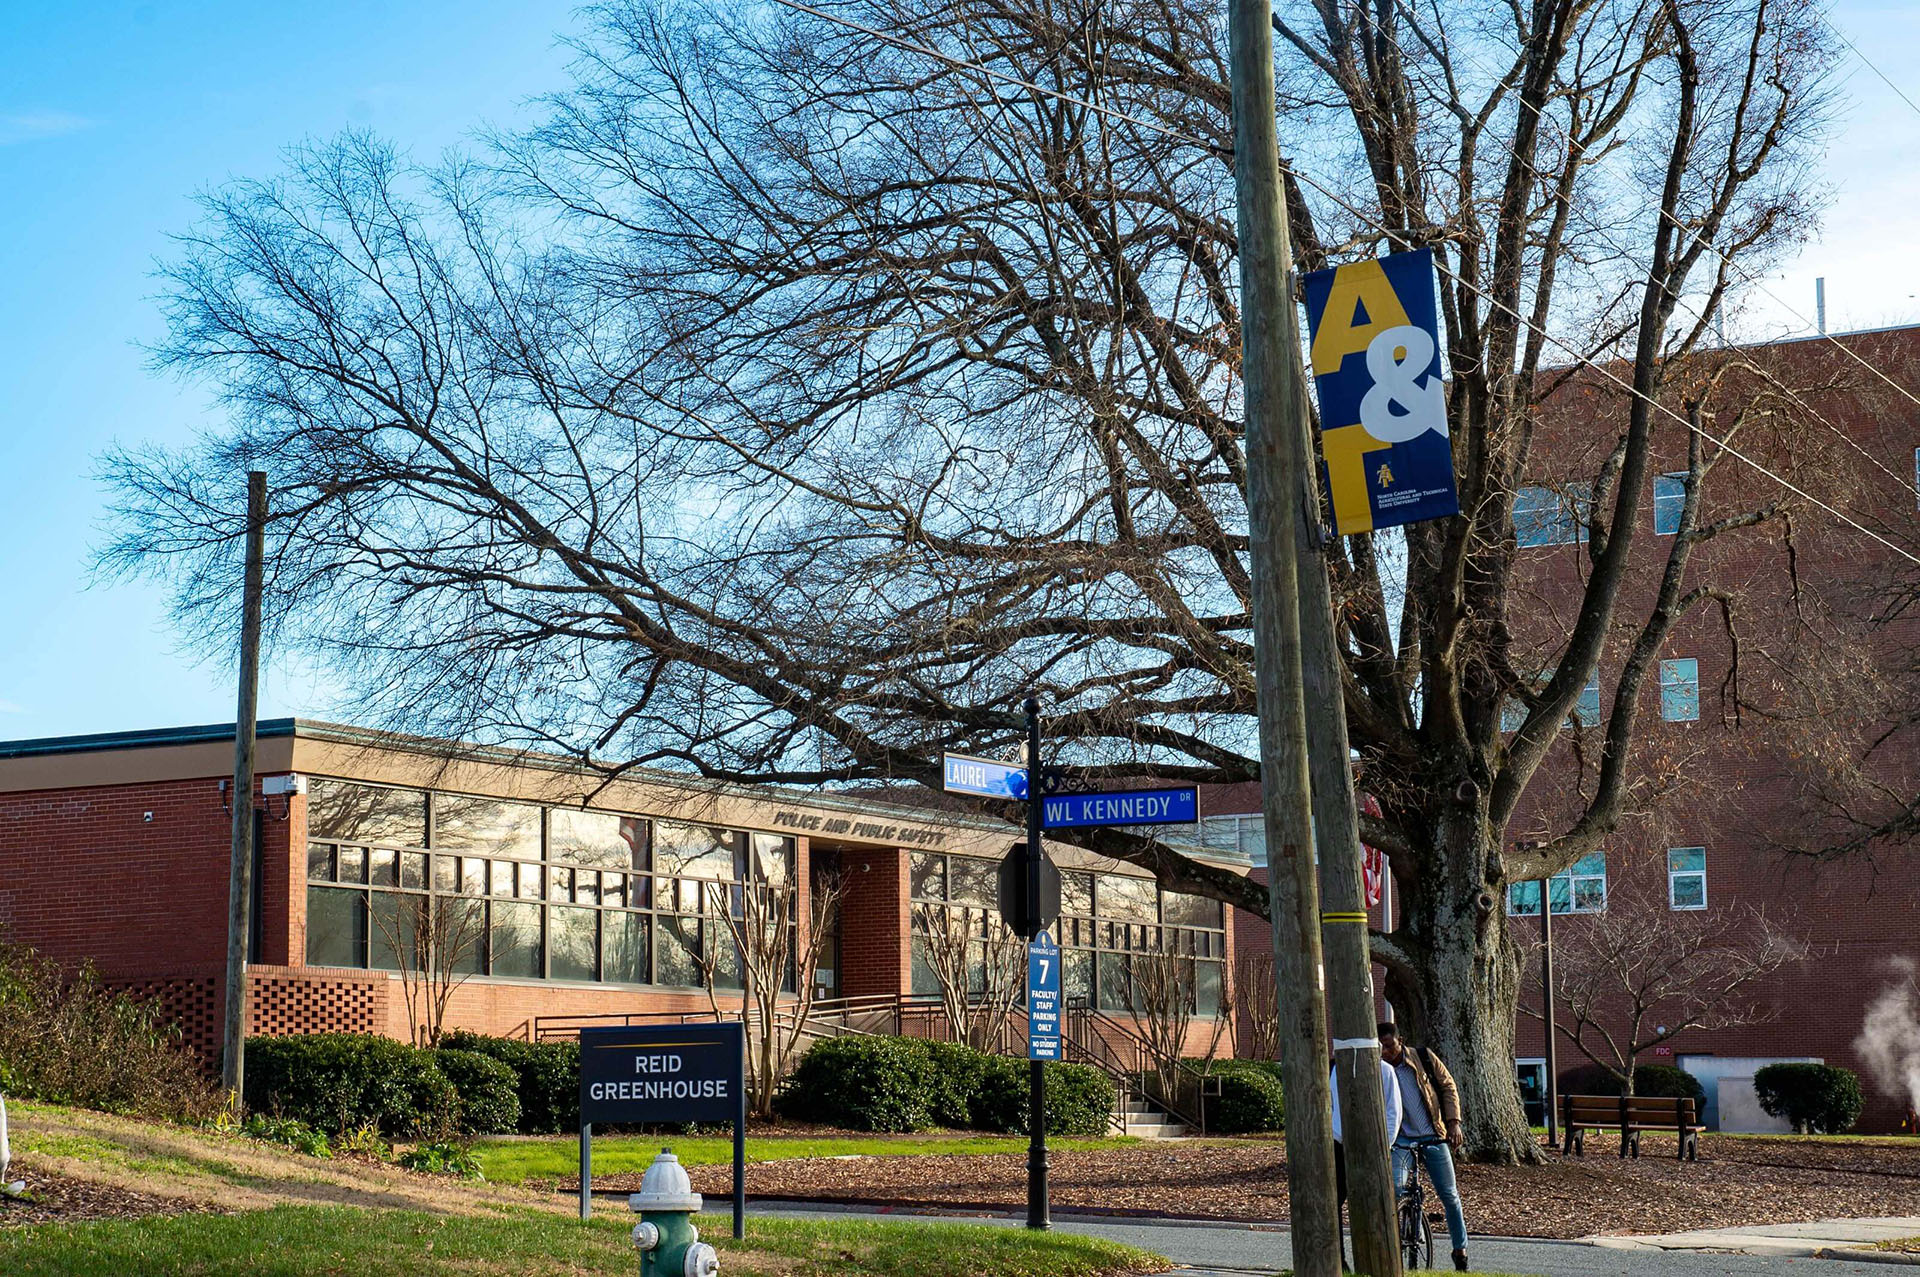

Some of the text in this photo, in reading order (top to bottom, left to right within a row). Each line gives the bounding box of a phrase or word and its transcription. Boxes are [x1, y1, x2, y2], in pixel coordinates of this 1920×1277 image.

[946, 762, 988, 788] LAUREL
[1046, 792, 1191, 822] WL KENNEDY DR
[773, 811, 946, 846] POLICE AND PUBLIC SAFETY
[1030, 947, 1049, 956] PARKING
[1039, 959, 1050, 985] 7
[1031, 990, 1058, 1000] FACULTY/
[1036, 1001, 1053, 1010] STAFF
[1032, 1012, 1057, 1022] PARKING
[1037, 1023, 1052, 1032] ONLY
[1039, 1041, 1058, 1049] STUDENT
[1655, 1047, 1670, 1055] FDC
[635, 1055, 682, 1073] REID
[590, 1080, 728, 1100] GREENHOUSE
